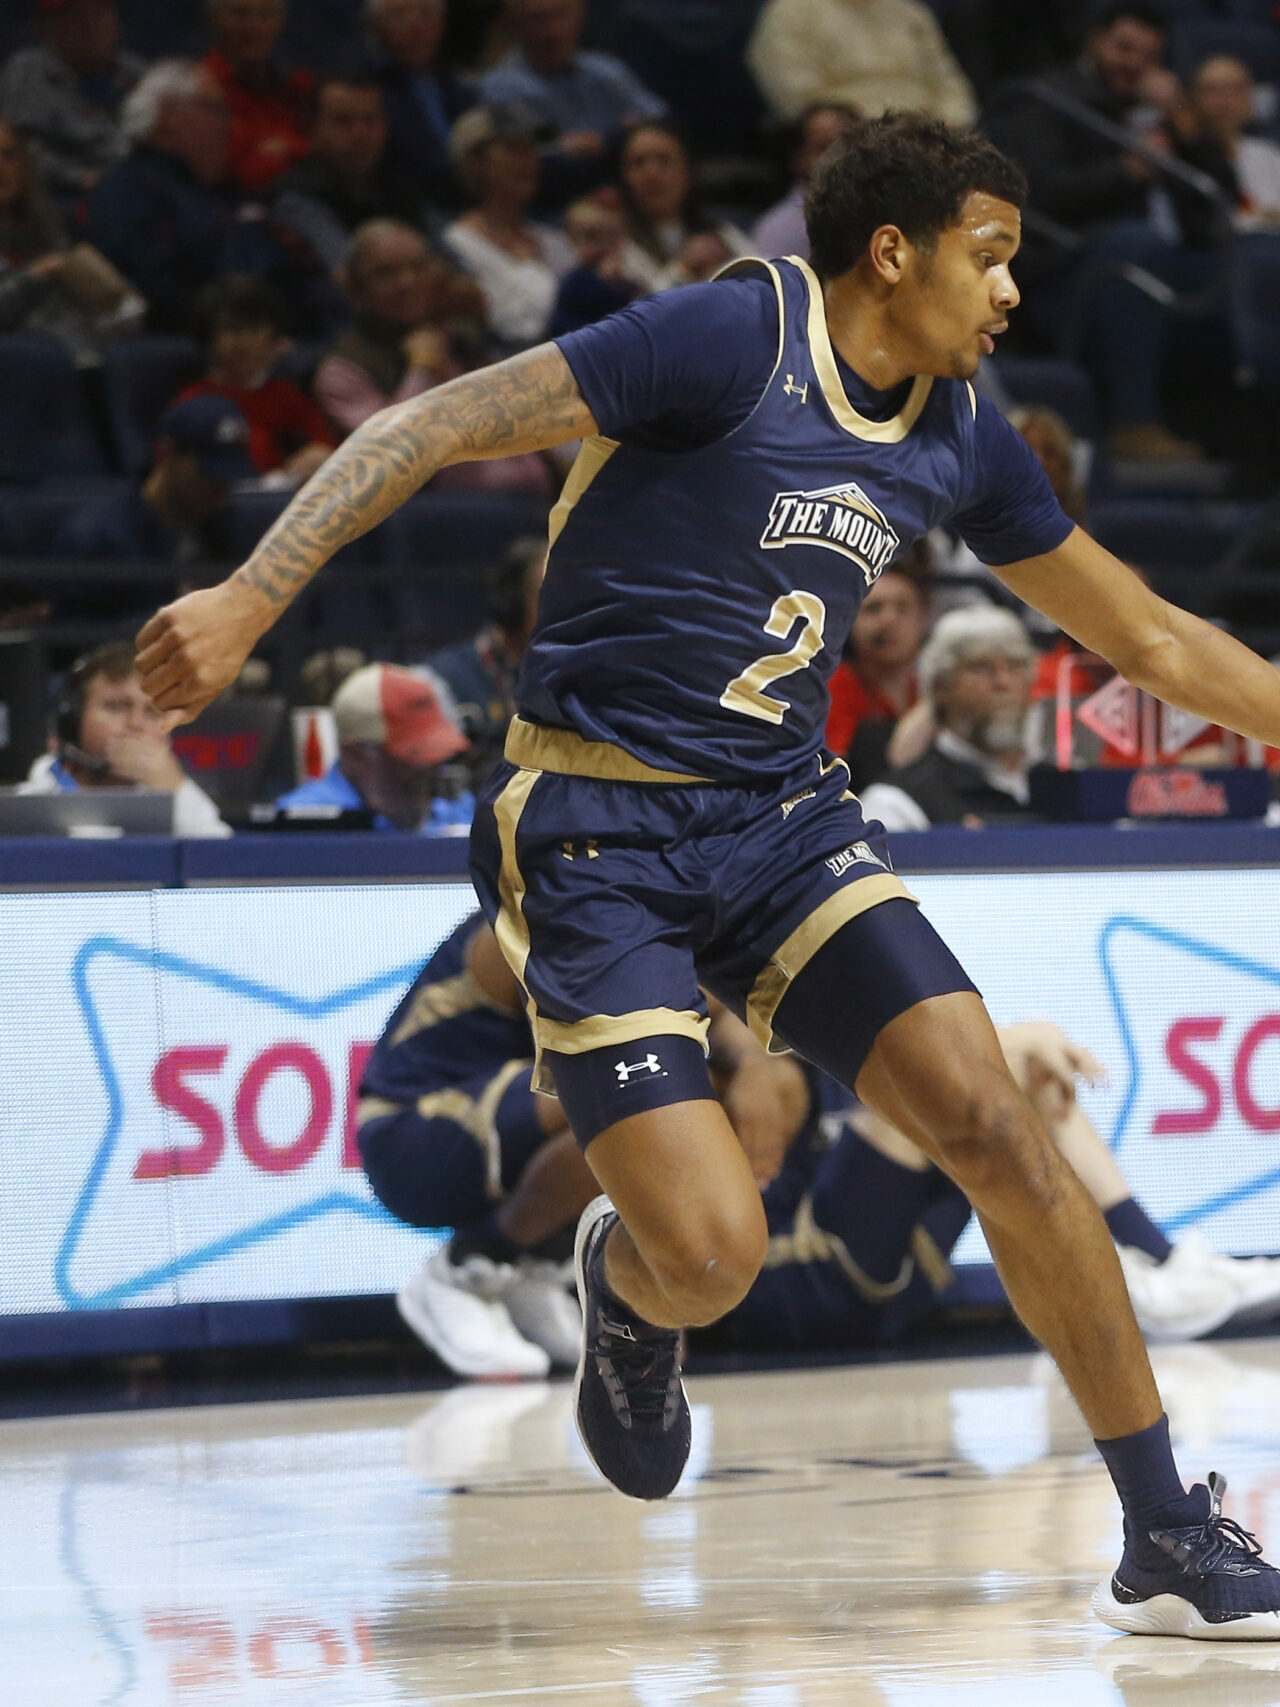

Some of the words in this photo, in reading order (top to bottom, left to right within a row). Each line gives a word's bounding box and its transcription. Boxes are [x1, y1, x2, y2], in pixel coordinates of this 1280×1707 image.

[770, 498, 829, 538] THE
[826, 505, 896, 567] MOUNT
[719, 589, 826, 725] 2
[828, 849, 855, 872] THE
